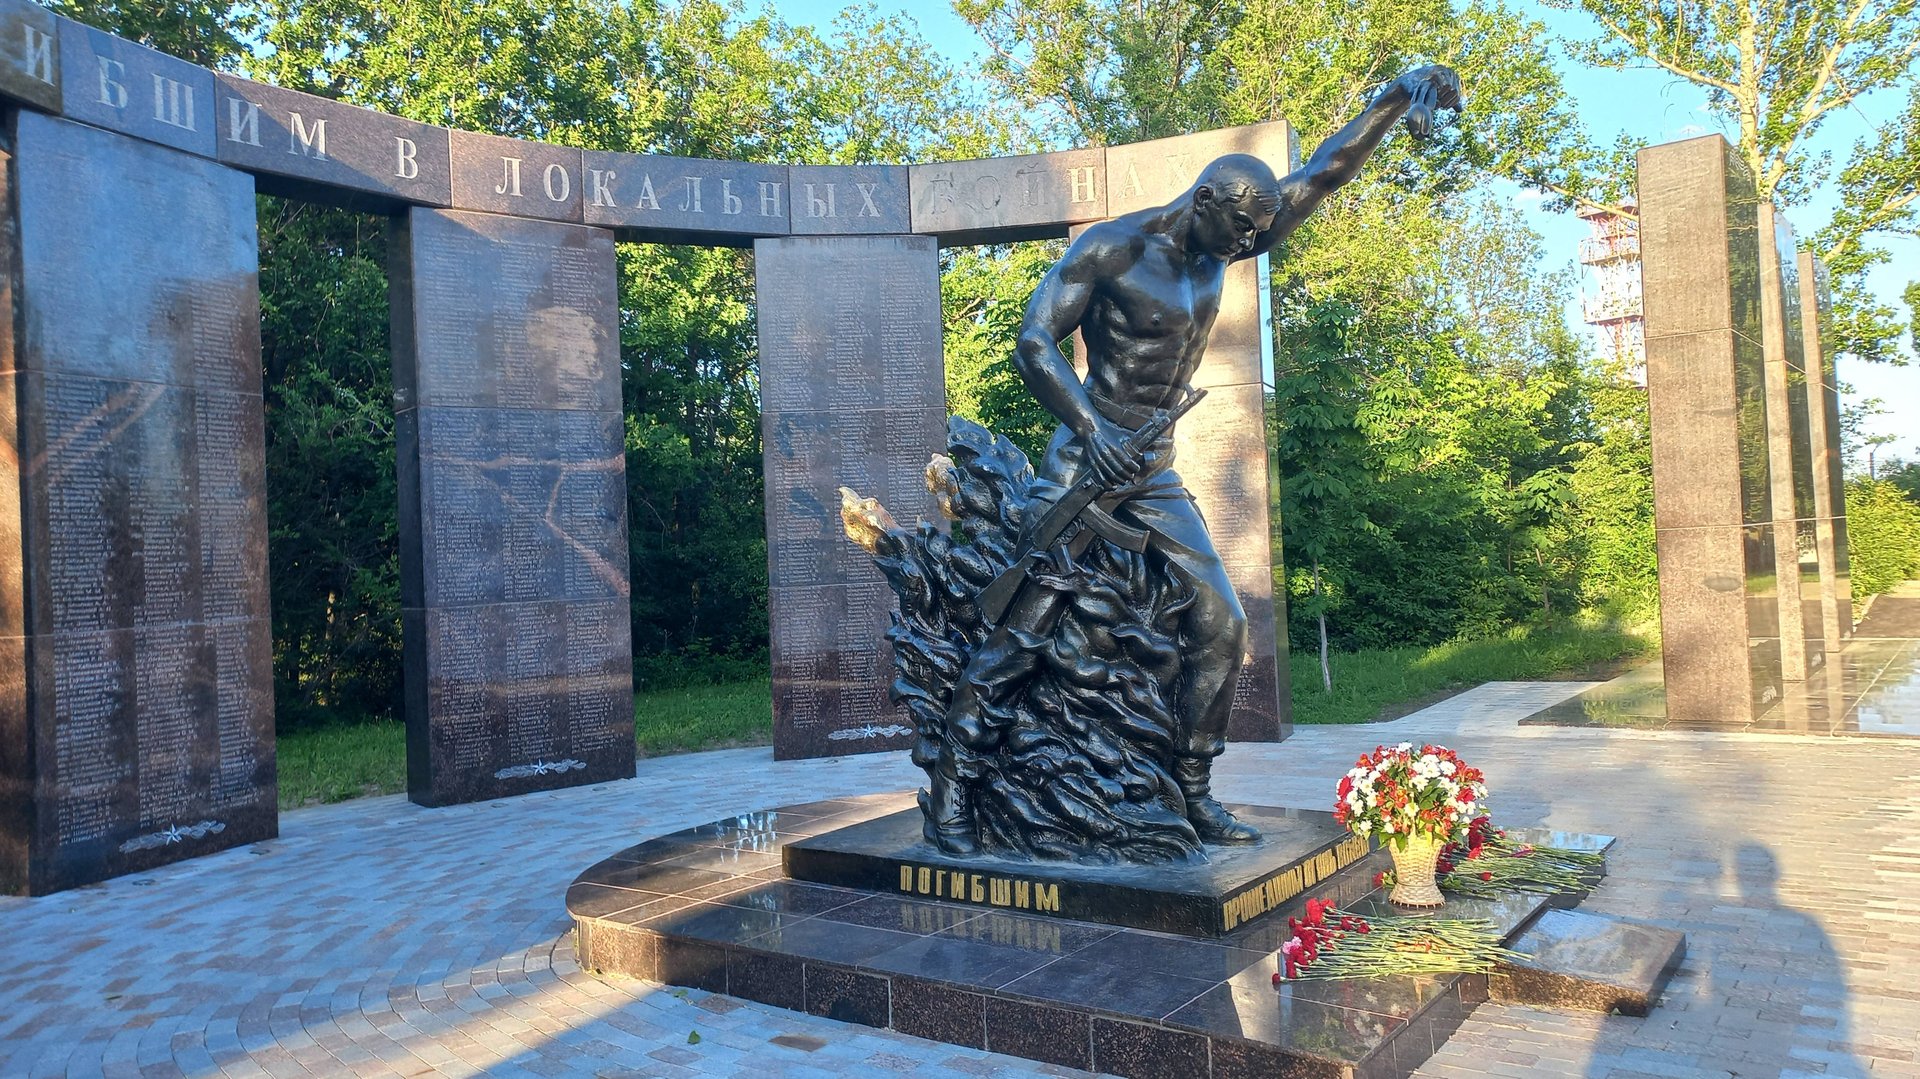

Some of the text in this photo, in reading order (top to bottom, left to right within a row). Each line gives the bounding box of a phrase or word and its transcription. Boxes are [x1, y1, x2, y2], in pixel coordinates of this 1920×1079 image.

[393, 136, 419, 179] В
[494, 156, 882, 218] ЛОКАЛЬНЫХ
[900, 864, 1060, 912] ПОГИБШИМ
[1222, 864, 1304, 932] ПРОШЕДШИМ
[1302, 847, 1338, 889] ОГОНЬ
